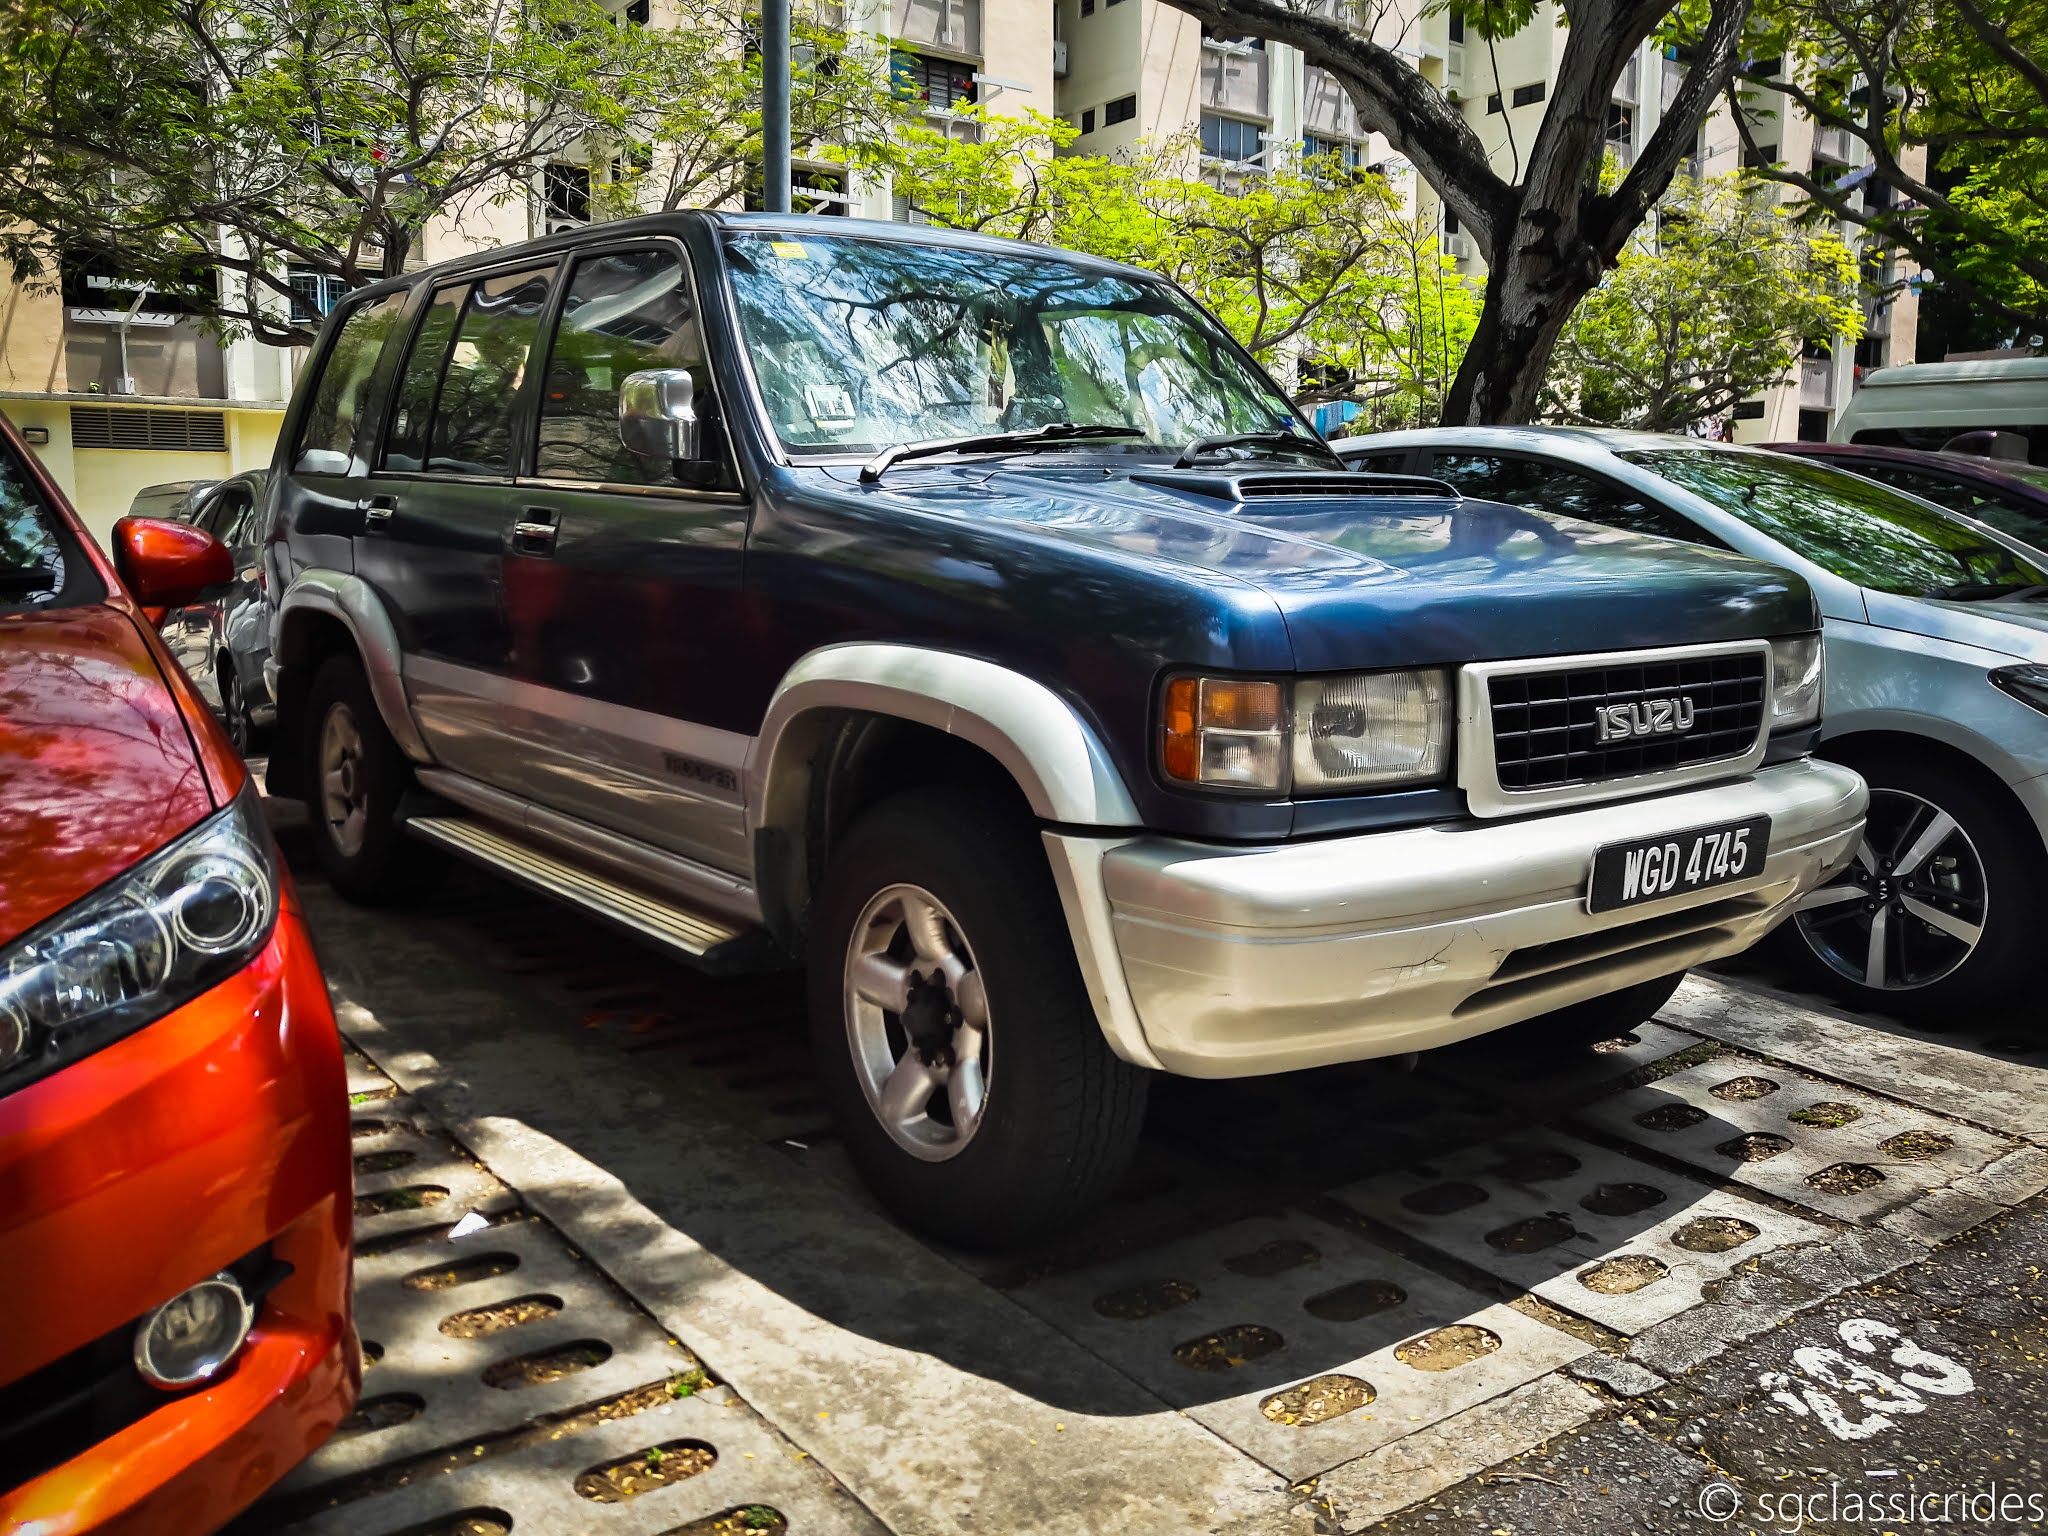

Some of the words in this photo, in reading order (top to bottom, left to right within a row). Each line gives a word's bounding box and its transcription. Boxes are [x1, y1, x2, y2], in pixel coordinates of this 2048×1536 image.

[1596, 696, 1694, 743] ISUZU
[1622, 843, 1680, 901] WGD
[1684, 828, 1750, 884] 4745
